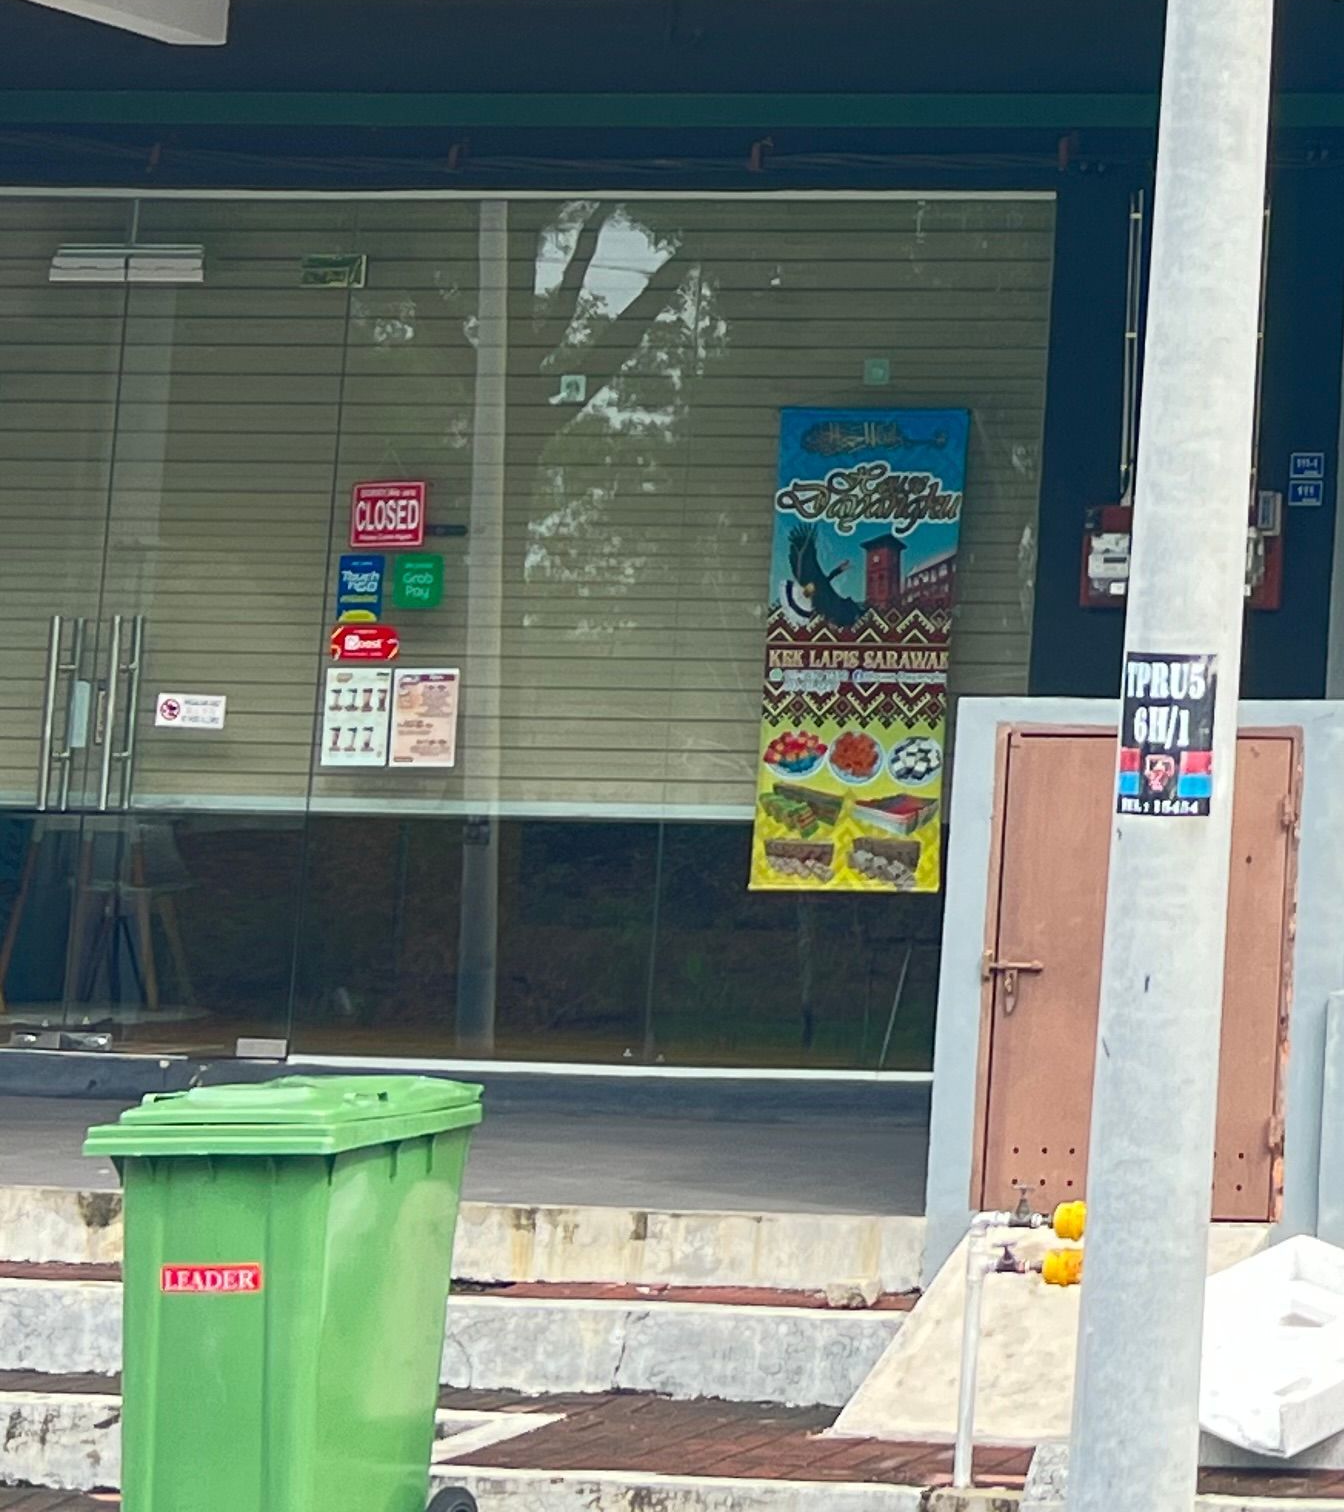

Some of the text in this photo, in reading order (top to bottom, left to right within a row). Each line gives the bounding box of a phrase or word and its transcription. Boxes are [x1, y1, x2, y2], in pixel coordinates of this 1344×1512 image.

[356, 500, 419, 532] CLOSED
[403, 572, 433, 584] Grab
[405, 585, 430, 600] Pay
[769, 649, 803, 668] KEK
[809, 650, 860, 668] LAPIS
[1133, 705, 1190, 750] 6H/1
[164, 1268, 255, 1289] LEADER
